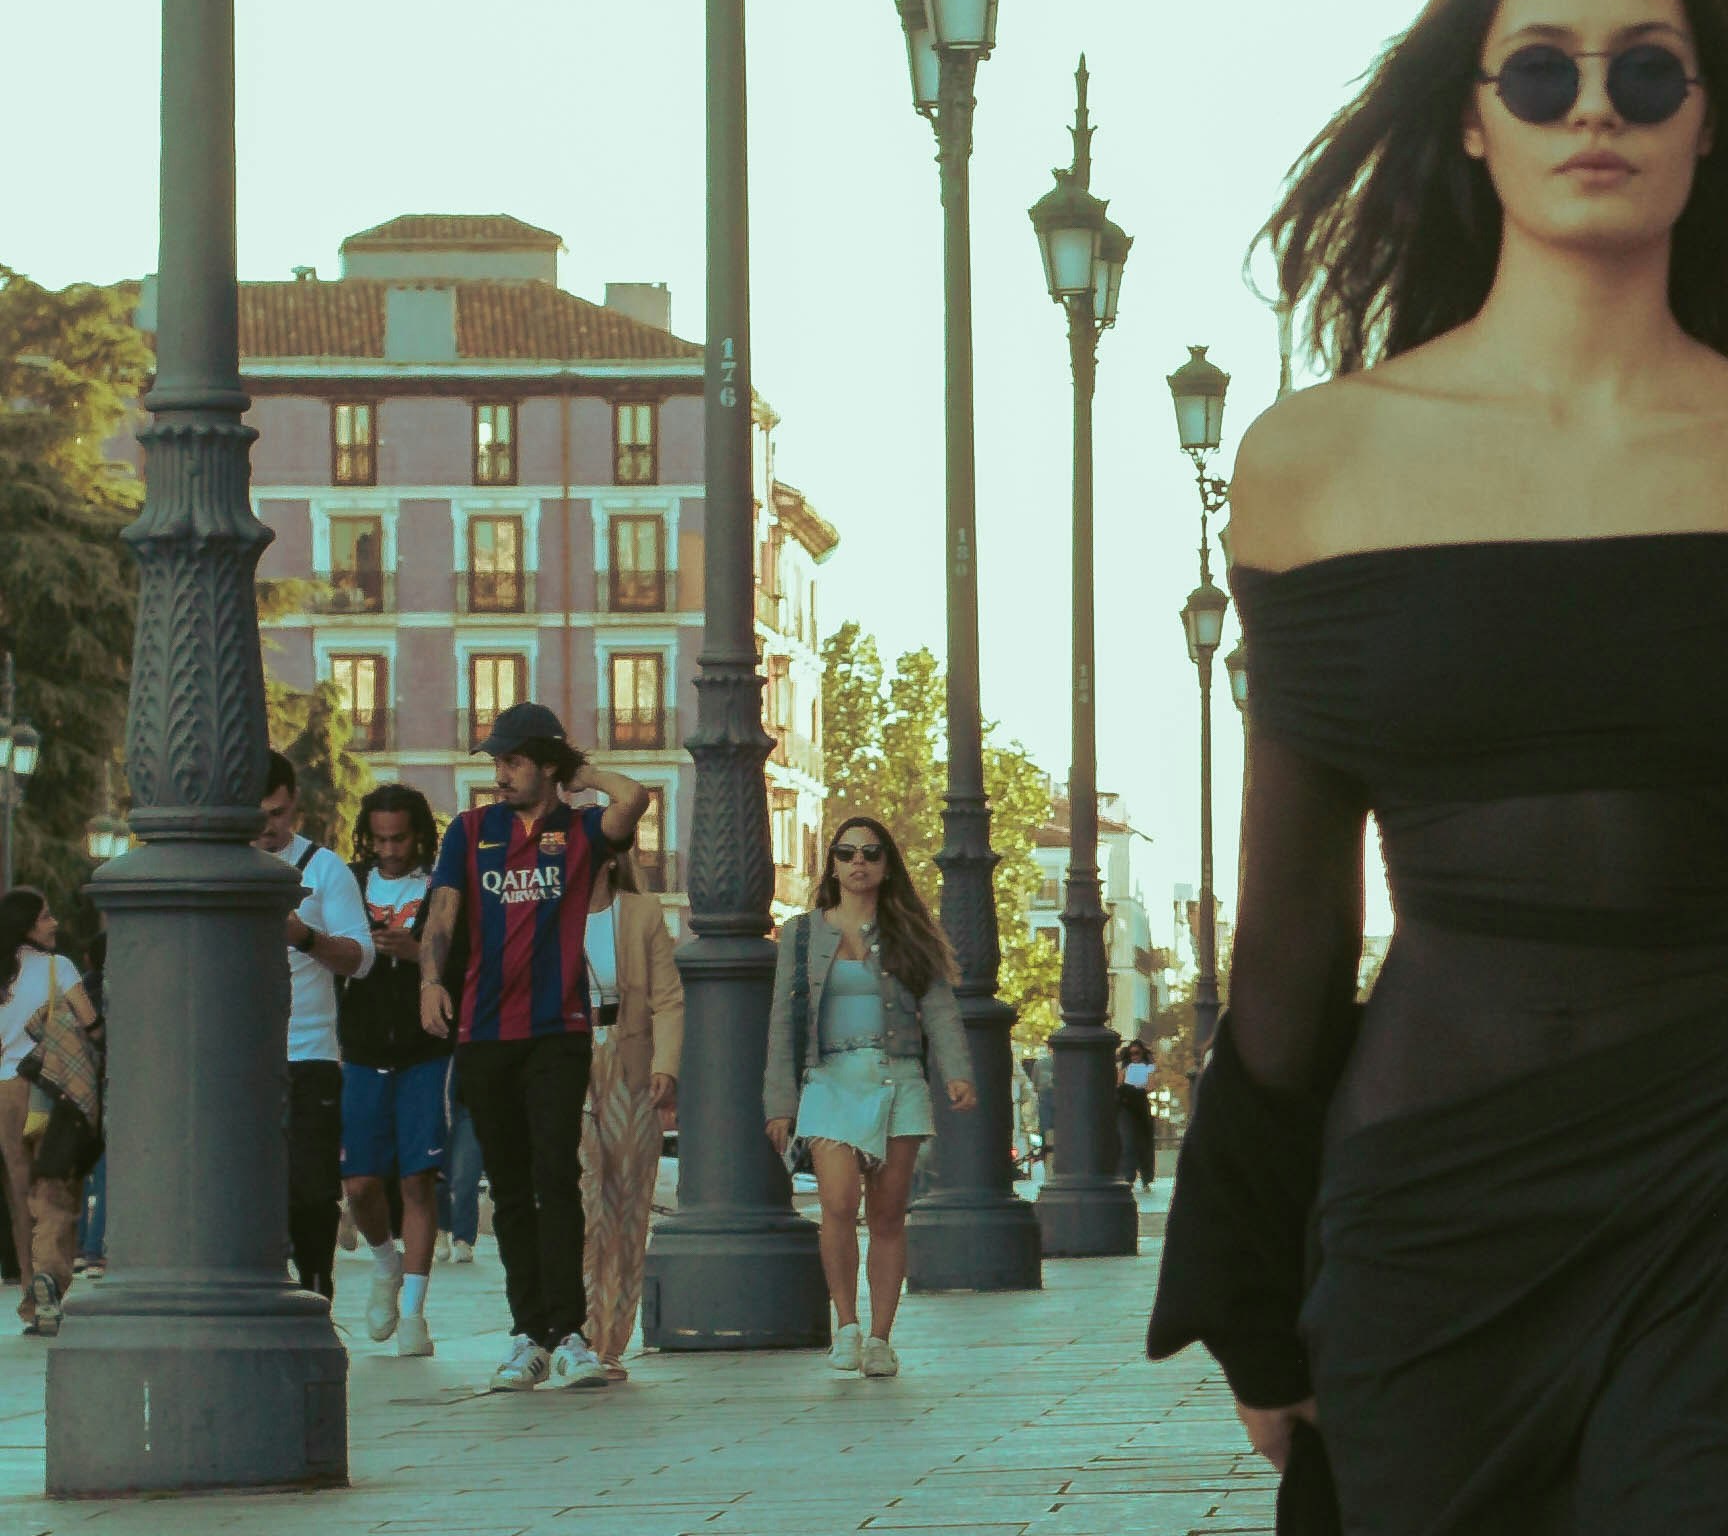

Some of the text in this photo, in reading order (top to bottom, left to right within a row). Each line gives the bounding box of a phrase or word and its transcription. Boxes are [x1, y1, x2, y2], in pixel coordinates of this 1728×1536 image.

[720, 337, 737, 408] 176
[482, 866, 561, 895] QATAR
[500, 886, 561, 904] AIRWAS
